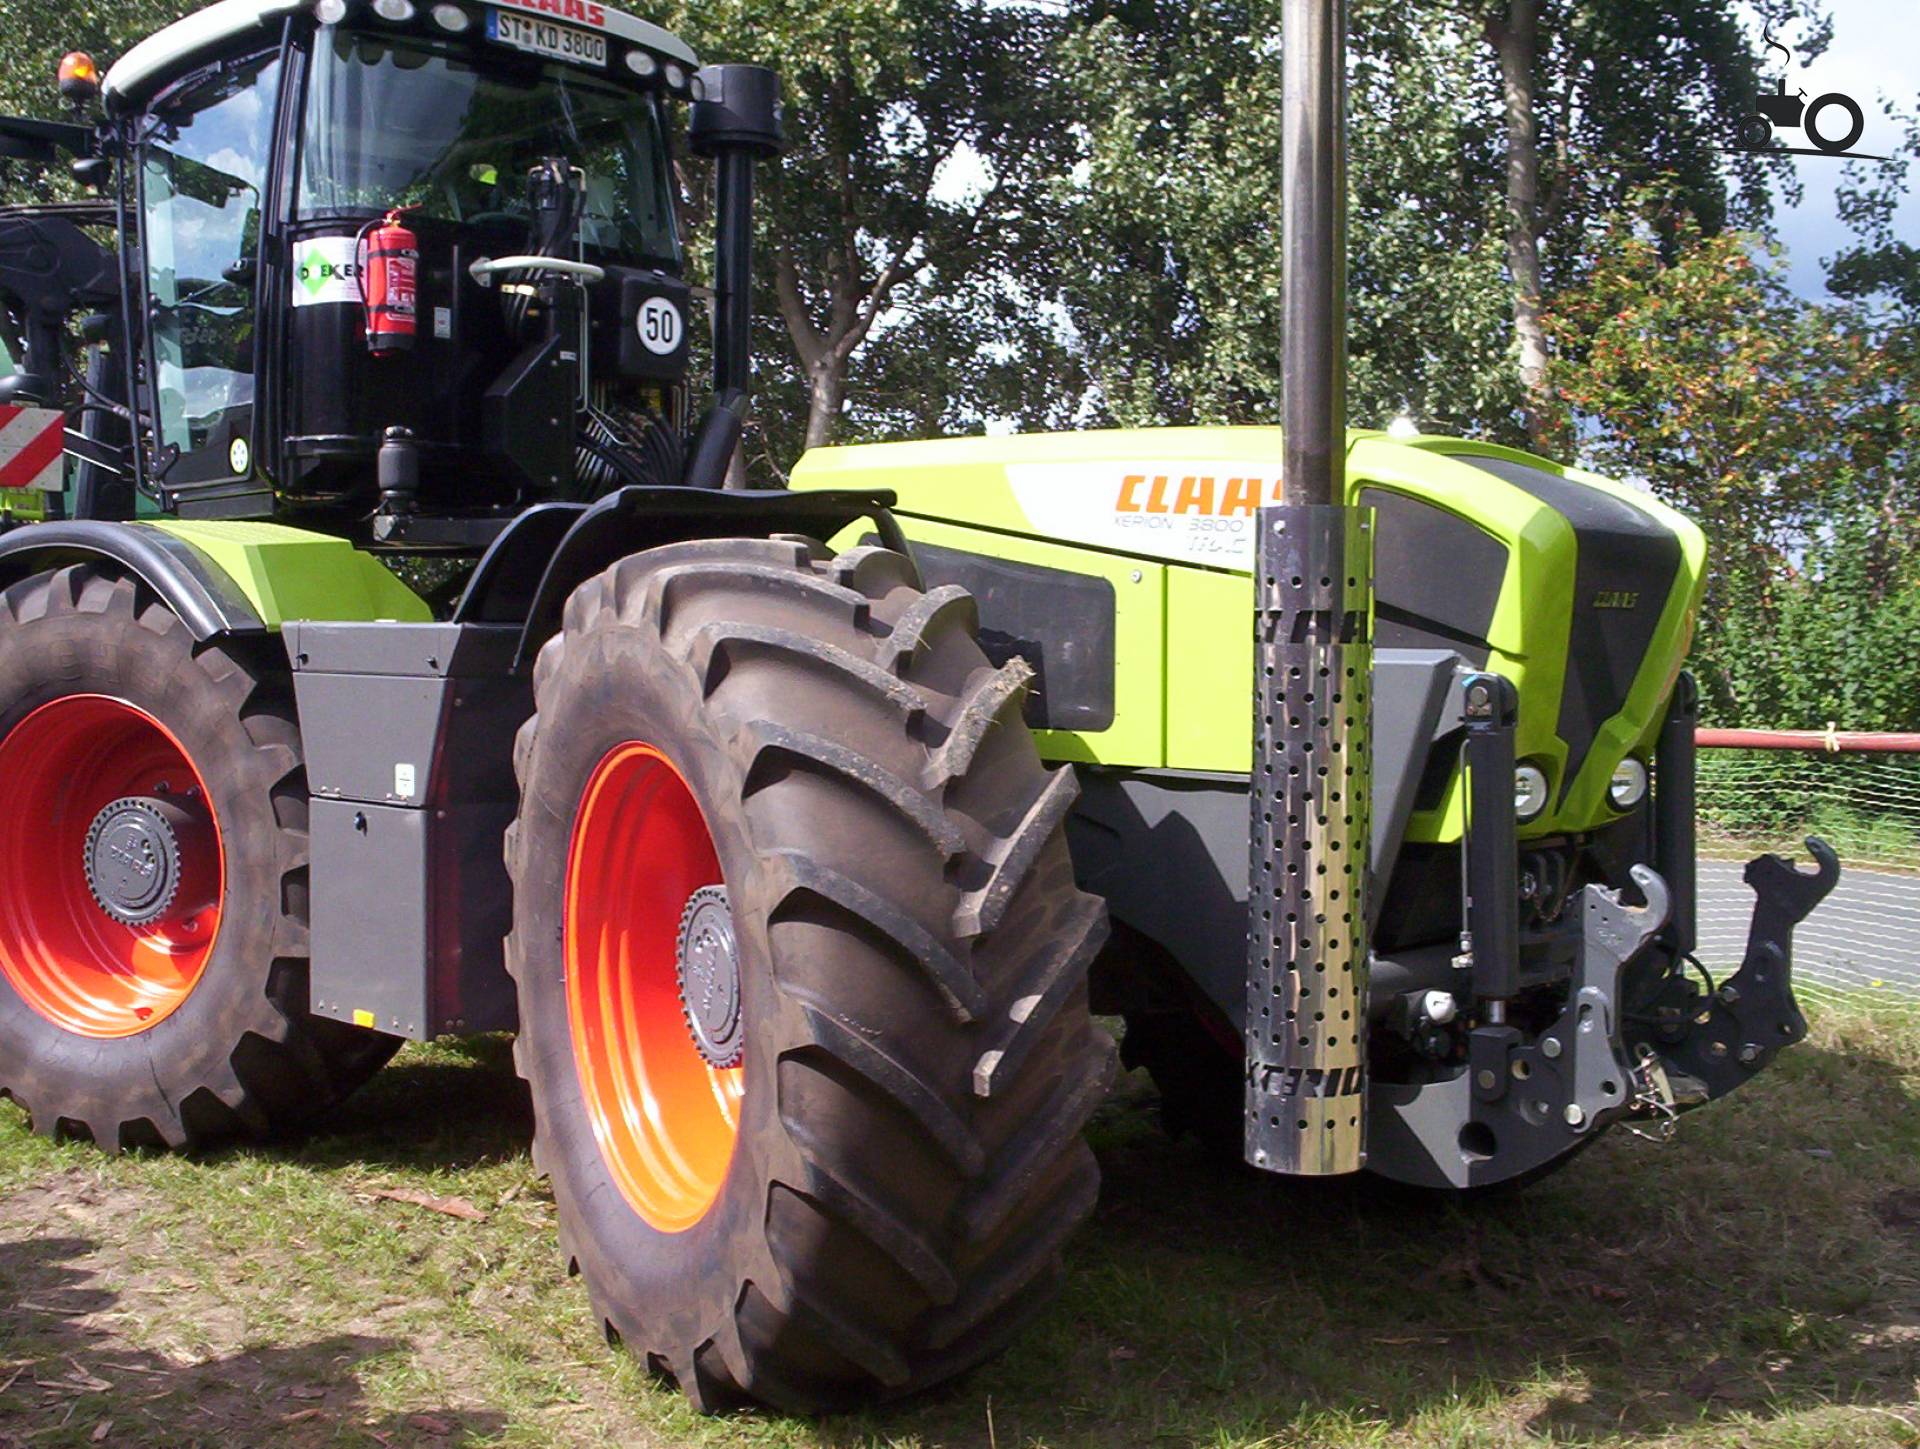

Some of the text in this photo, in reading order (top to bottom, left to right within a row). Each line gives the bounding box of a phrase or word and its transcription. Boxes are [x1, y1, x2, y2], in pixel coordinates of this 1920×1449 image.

[499, 14, 521, 40] ST
[562, 31, 604, 61] 3800
[646, 307, 673, 343] 50
[1115, 475, 1282, 517] CLAA
[1188, 518, 1244, 533] 3800
